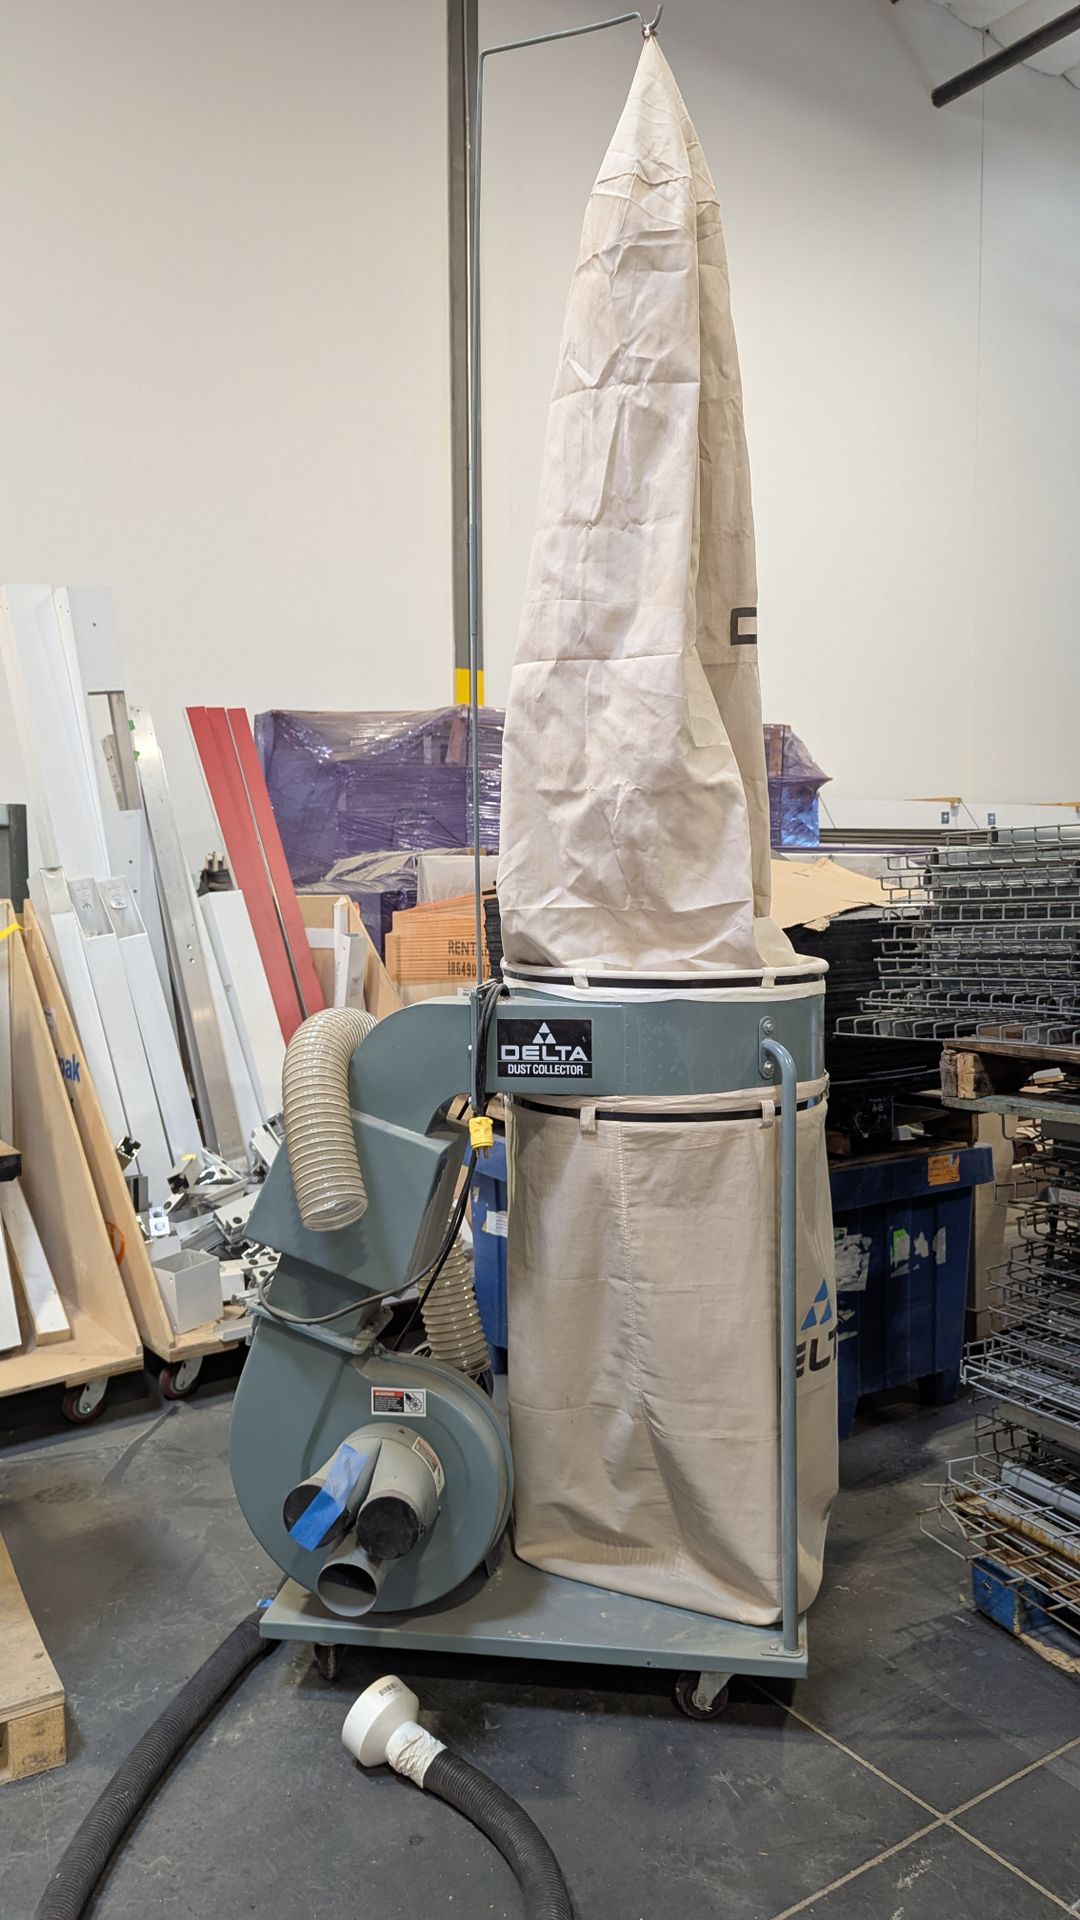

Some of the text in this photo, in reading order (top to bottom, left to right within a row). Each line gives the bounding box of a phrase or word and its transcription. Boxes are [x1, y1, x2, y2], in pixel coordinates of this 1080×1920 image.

[501, 1045, 588, 1061] DELTA
[508, 1064, 583, 1075] DUST COLLECTOR
